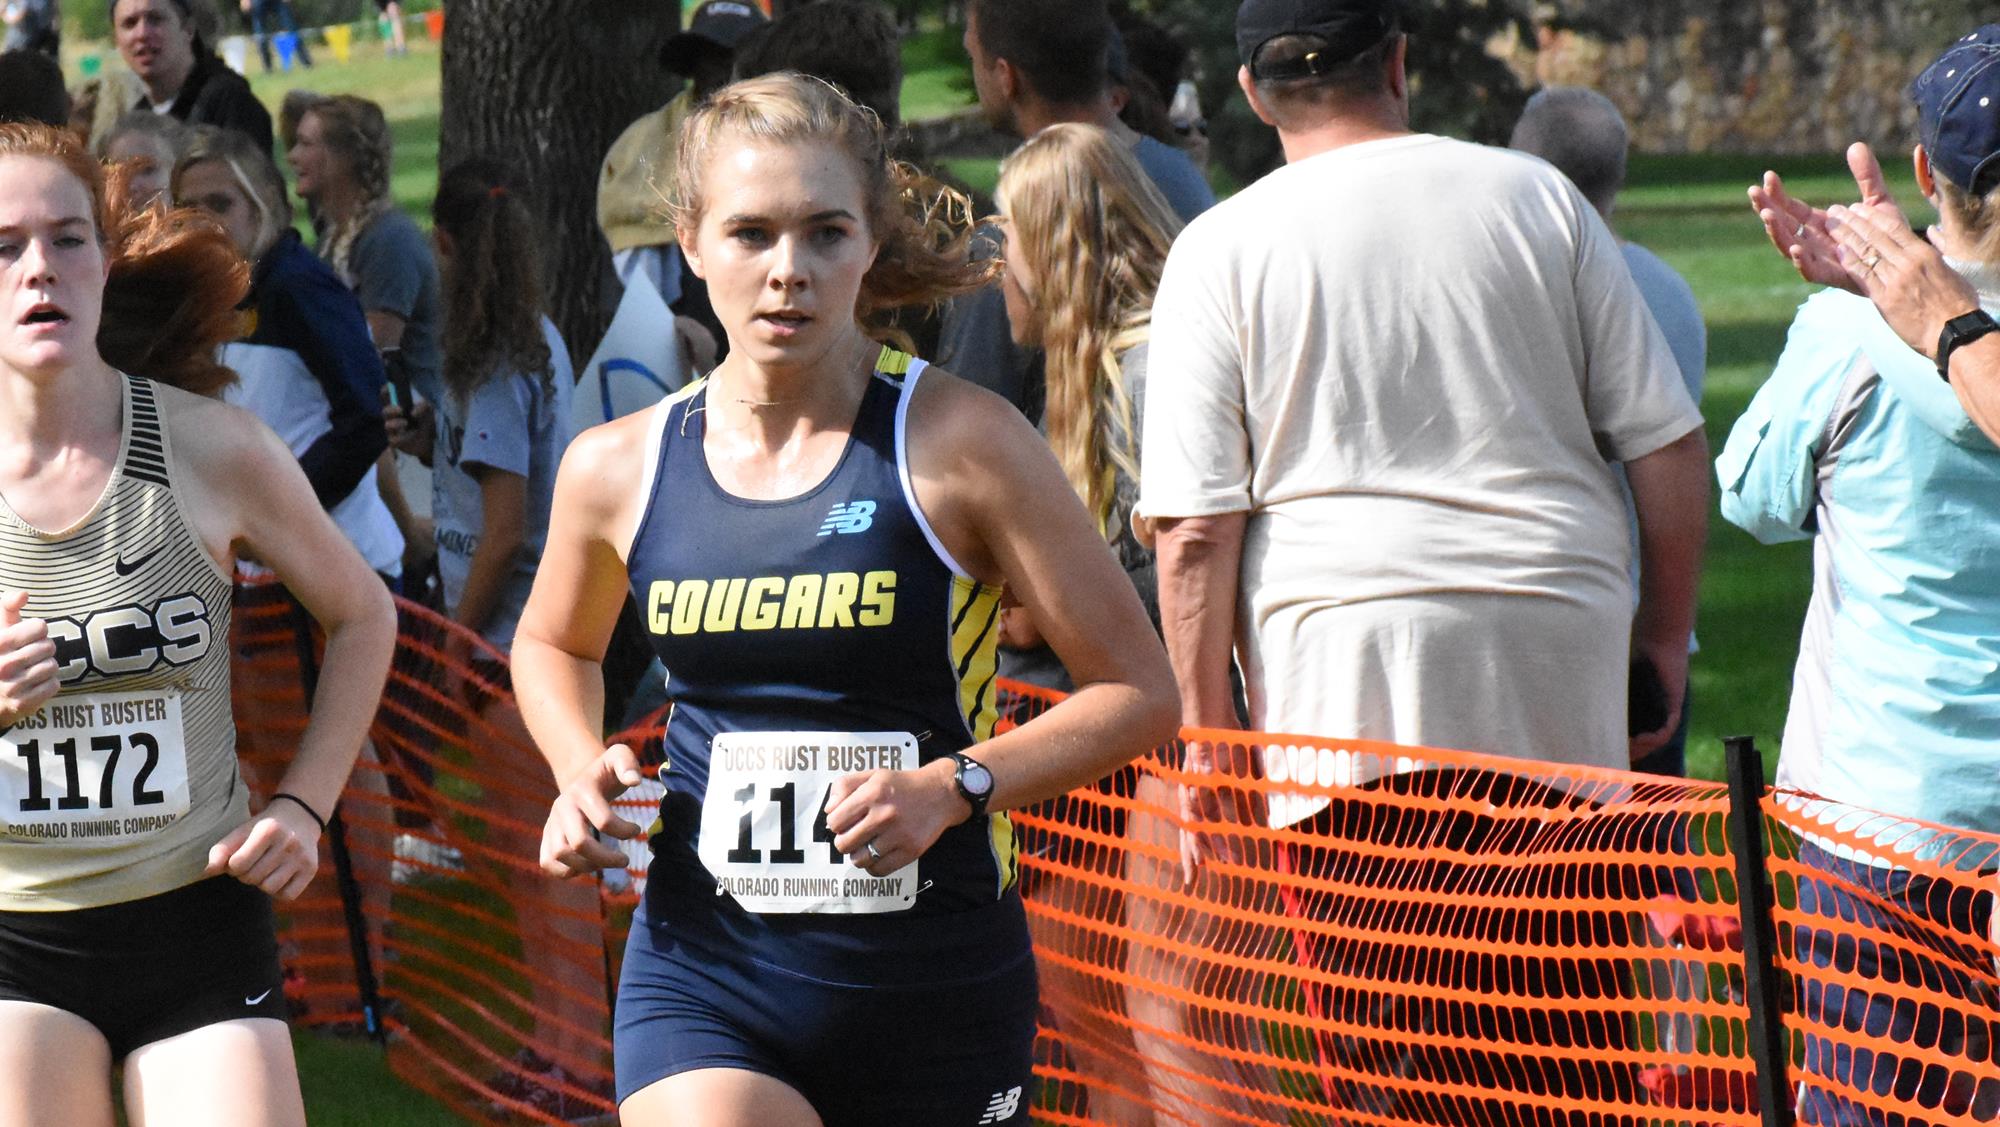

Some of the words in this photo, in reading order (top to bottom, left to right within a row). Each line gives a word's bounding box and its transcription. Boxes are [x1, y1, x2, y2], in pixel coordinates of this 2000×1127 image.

[648, 570, 897, 635] COUGARS
[52, 704, 96, 729] RUST
[101, 697, 167, 726] BUSTER
[16, 732, 165, 812] 1172
[724, 747, 767, 772] UCCS
[772, 746, 821, 771] RUST
[827, 746, 903, 771] BUSTER
[8, 821, 69, 839] COLORADO
[70, 818, 122, 838] RUNNING
[123, 813, 177, 836] COMPANY
[783, 878, 839, 898] RUNNING
[842, 877, 903, 898] COMPANY
